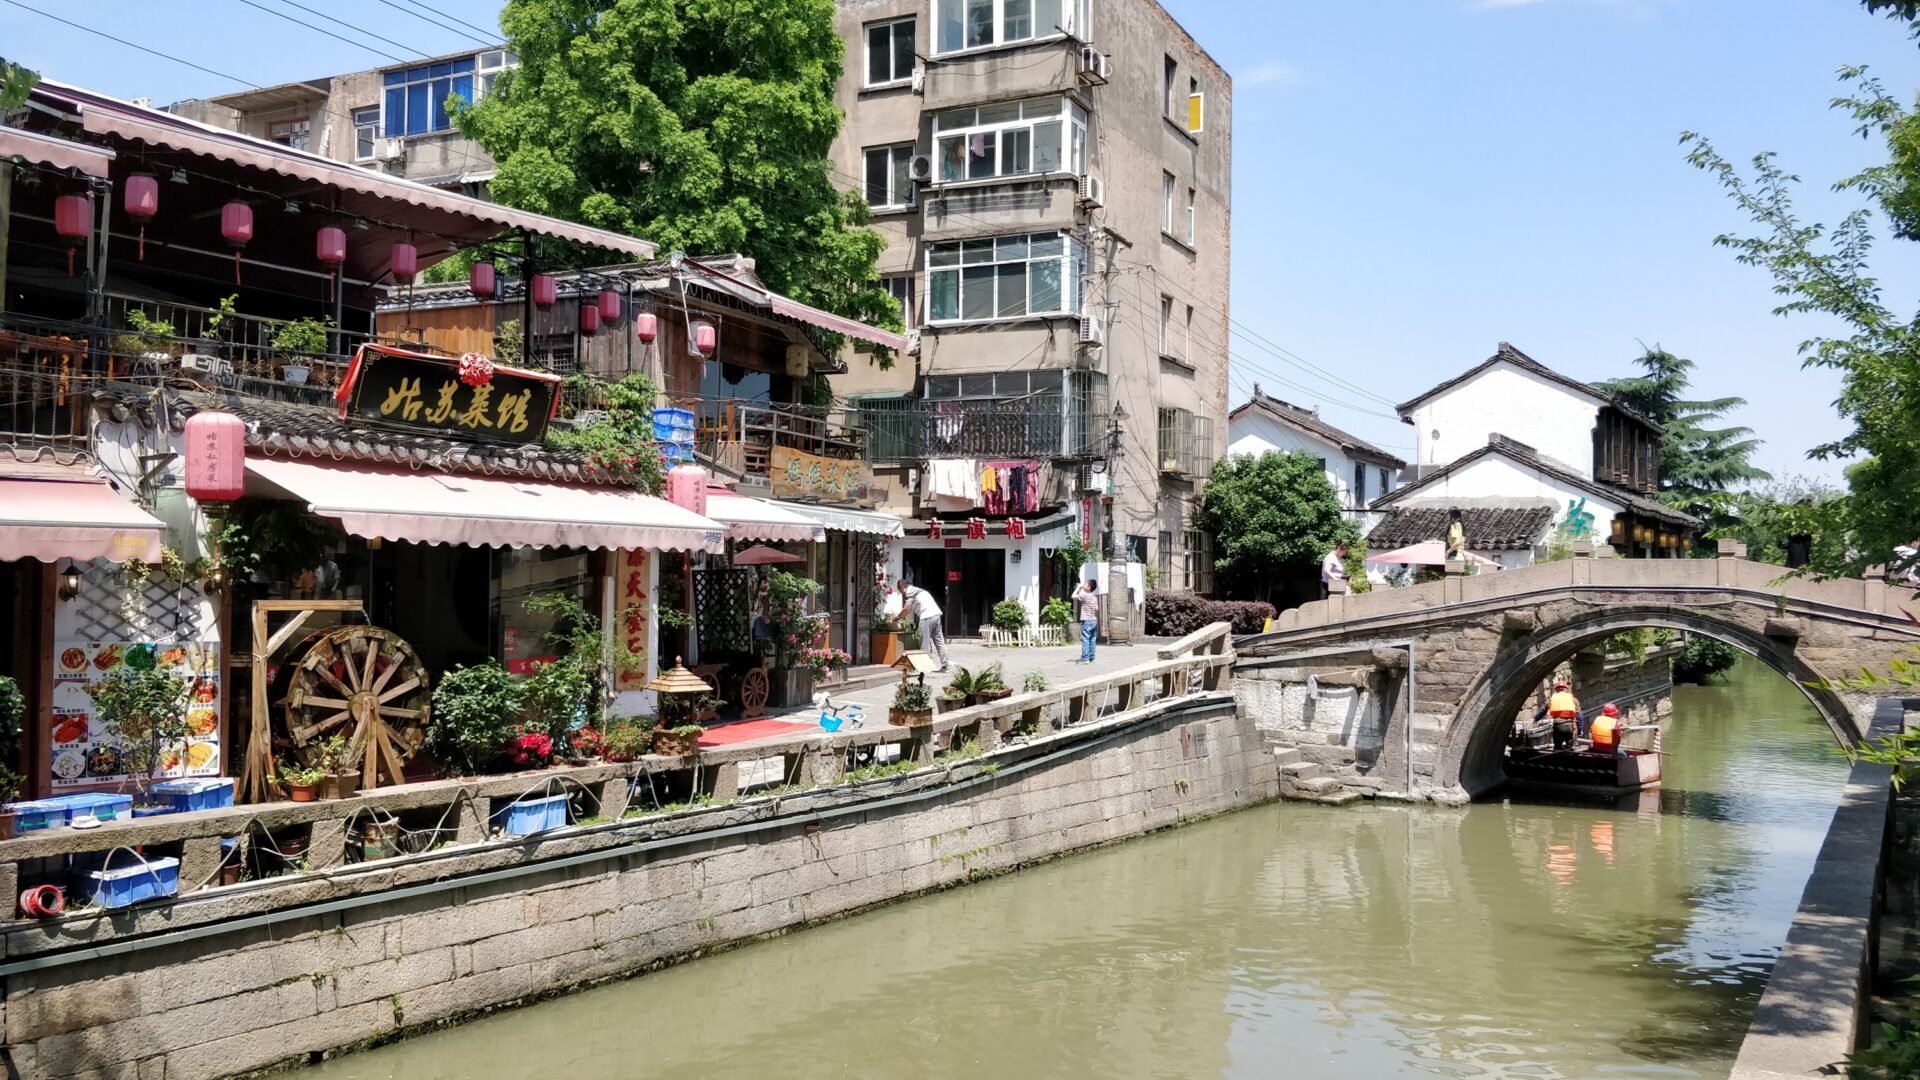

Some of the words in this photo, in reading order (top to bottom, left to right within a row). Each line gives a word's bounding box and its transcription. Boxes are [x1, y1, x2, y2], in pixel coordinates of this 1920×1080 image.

[380, 377, 531, 433] 姑苏菜馆
[884, 517, 1026, 540] 方旗袍
